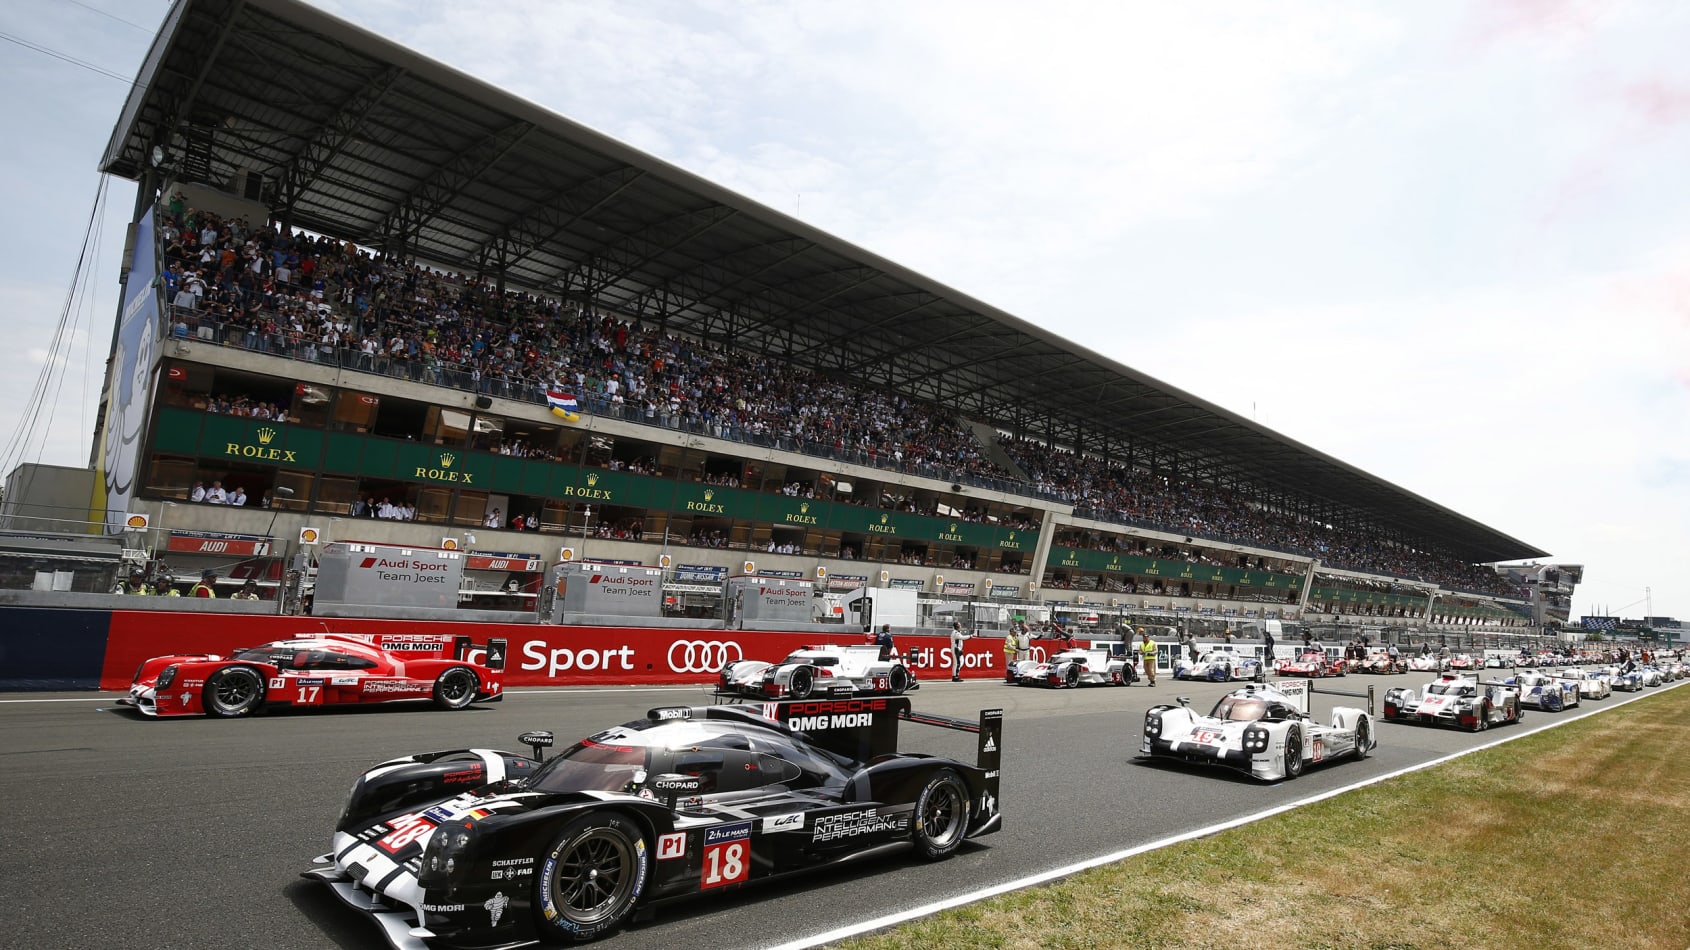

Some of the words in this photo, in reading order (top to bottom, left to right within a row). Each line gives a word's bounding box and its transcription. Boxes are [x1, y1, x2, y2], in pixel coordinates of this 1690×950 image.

[225, 443, 296, 462] ROLEX
[415, 467, 473, 483] ROLEX
[565, 486, 611, 500] ROLEX
[687, 501, 724, 513] ROLEX
[786, 513, 817, 524] ROLEX
[868, 524, 896, 534] ROLEX
[939, 532, 963, 542] ROLEX
[199, 541, 228, 552] AUDI
[1000, 540, 1019, 549] ROLEX
[378, 559, 409, 569] Audi
[412, 560, 448, 571] Sport
[489, 560, 509, 569] AUDI
[528, 561, 535, 570] 9
[1061, 559, 1079, 567] ROLEX
[376, 571, 411, 582] Team
[414, 573, 446, 583] Joest
[602, 576, 625, 584] Audi
[627, 577, 653, 586] Sport
[602, 586, 627, 595] Team
[629, 588, 652, 596] Joest
[766, 588, 784, 596] Audi
[786, 589, 807, 597] Sport
[766, 597, 786, 605] Team
[382, 634, 453, 643] PORSCHE
[412, 643, 444, 651] MORI
[521, 641, 635, 677] Sport
[271, 679, 283, 687] P1
[878, 678, 885, 689] 8
[297, 687, 320, 703] 17
[789, 700, 887, 715] PORSCHE
[660, 709, 683, 721] Mobil
[788, 716, 828, 732] DMG
[831, 713, 873, 729] MORI
[523, 736, 553, 744] CHOPARD
[656, 781, 699, 790] CHOPARD
[774, 814, 801, 827] WEC
[814, 808, 877, 827] PORSCHE
[814, 814, 894, 835] INTELLIGENT
[730, 828, 749, 837] MANS
[812, 819, 908, 843] PERFORMANCE
[662, 837, 681, 856] P1
[492, 857, 534, 867] SCHAEFFLER
[706, 843, 744, 885] 18
[518, 867, 533, 876] FAG
[636, 856, 647, 893] MICHELIN
[543, 860, 554, 902] MICHELIN
[437, 904, 465, 912] MORI
